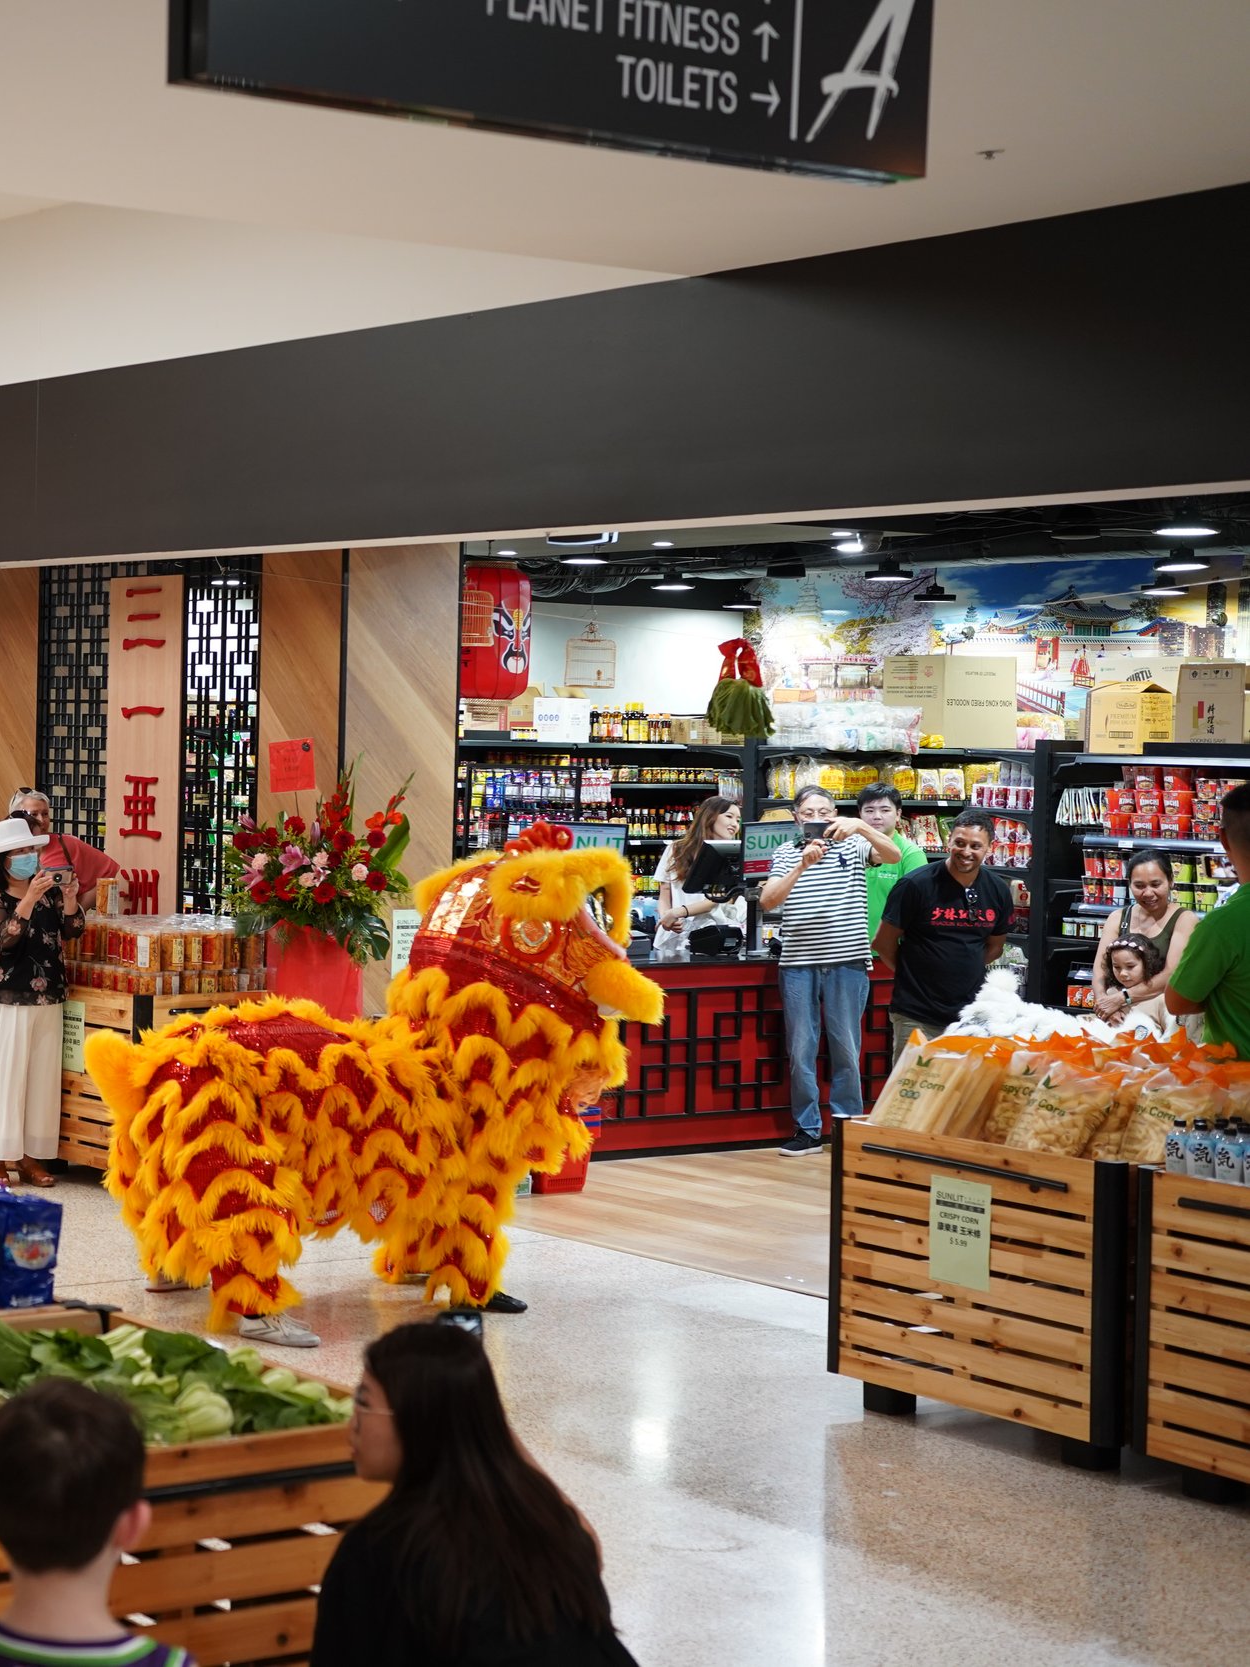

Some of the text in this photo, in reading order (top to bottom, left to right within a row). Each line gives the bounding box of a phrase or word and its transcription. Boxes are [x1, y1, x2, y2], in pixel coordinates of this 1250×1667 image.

[617, 0, 741, 56] FITNESS
[616, 55, 739, 114] TOILETS
[946, 698, 970, 706] NOODLES
[971, 699, 985, 707] FRIED
[919, 1080, 945, 1092] Corn
[1037, 1098, 1066, 1118] Corn
[1149, 1106, 1177, 1122] Corn
[936, 1190, 964, 1201] SUNLIT
[939, 1211, 979, 1225] CRISPY CORN
